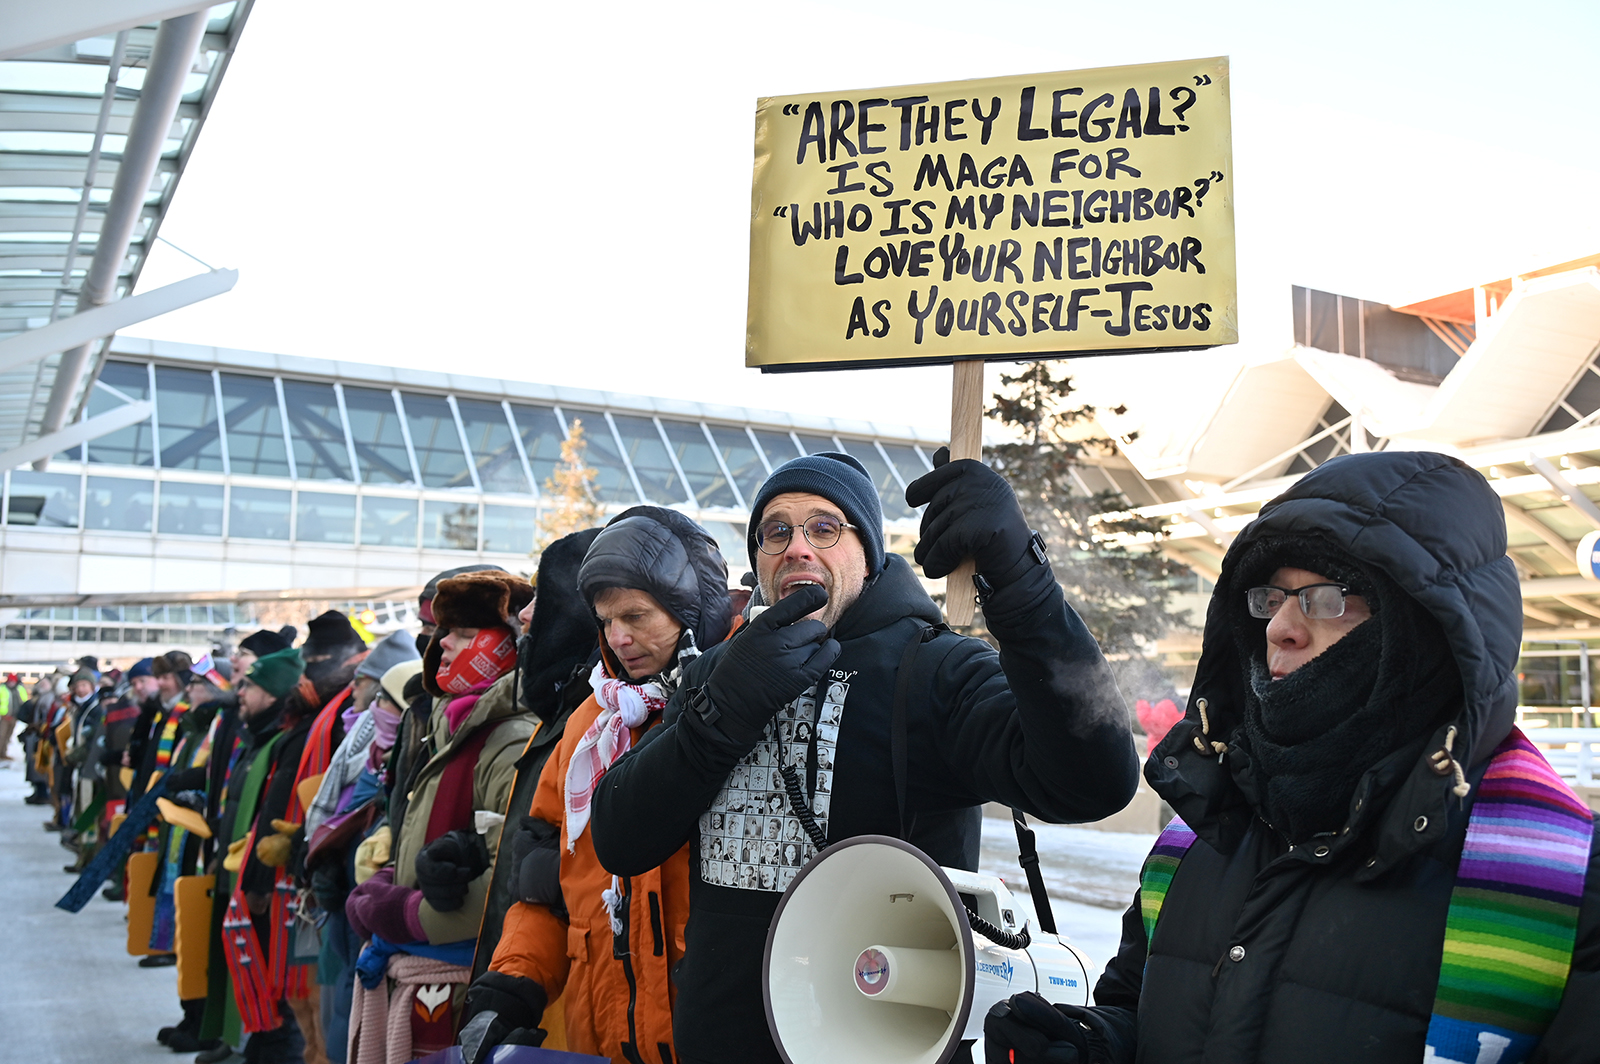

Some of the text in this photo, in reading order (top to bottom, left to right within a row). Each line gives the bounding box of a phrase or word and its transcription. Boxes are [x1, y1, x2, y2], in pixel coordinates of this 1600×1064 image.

[891, 95, 1001, 151] THEY
[827, 147, 1141, 198] IS MAGA FOR
[880, 198, 937, 236] IS
[945, 193, 1004, 230] MY
[835, 233, 1205, 286] LOVE YOUR NEIGHBOR
[846, 297, 891, 340] AS
